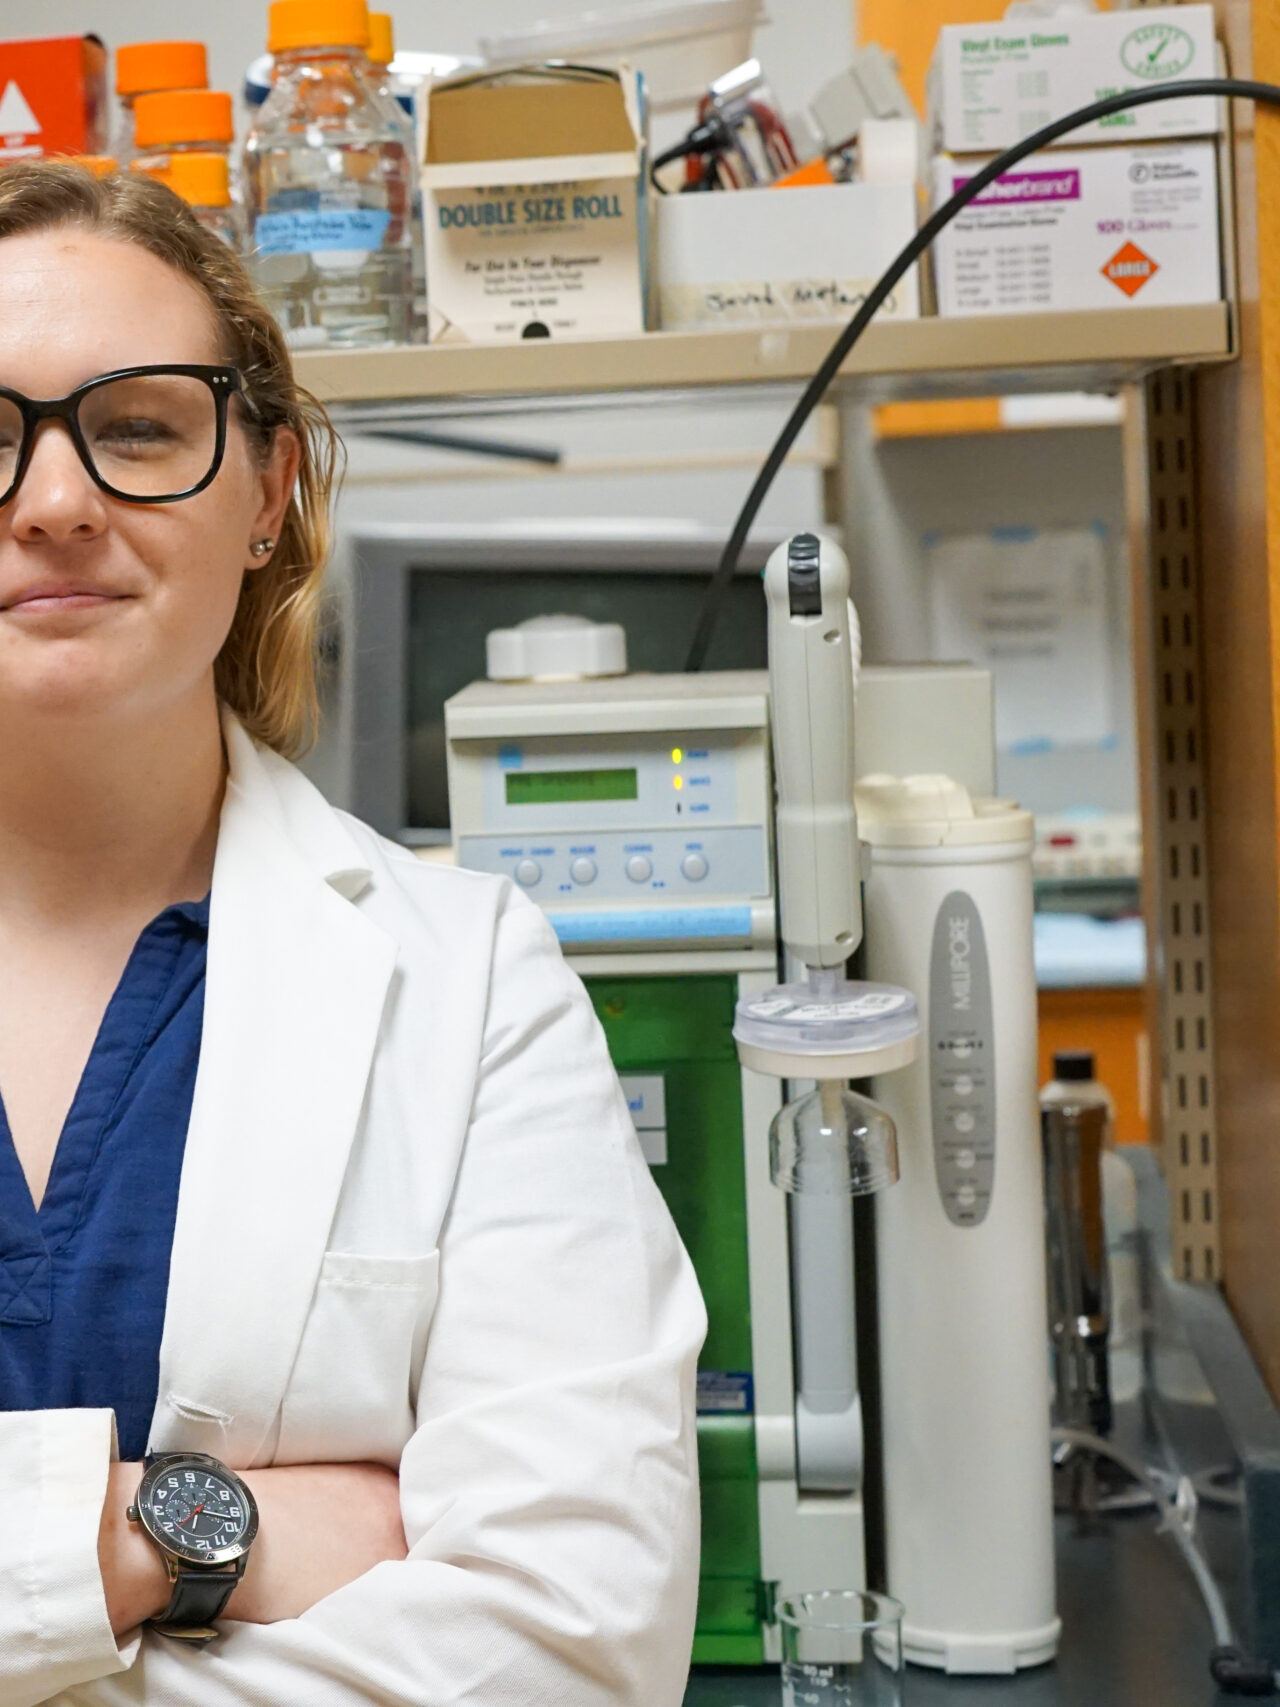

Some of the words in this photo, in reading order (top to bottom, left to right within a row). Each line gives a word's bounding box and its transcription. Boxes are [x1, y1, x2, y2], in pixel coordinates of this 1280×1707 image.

[439, 202, 516, 229] DOUBLE
[524, 197, 567, 223] SIZE
[573, 194, 622, 219] ROLL
[167, 1477, 179, 1488] 5
[184, 1472, 196, 1483] 6
[205, 1478, 215, 1488] 7
[156, 1488, 168, 1499] 4
[219, 1490, 230, 1501] 8
[153, 1505, 165, 1516] 3
[229, 1507, 240, 1518] 9
[162, 1521, 174, 1533] 2
[225, 1521, 240, 1533] 10
[180, 1535, 188, 1545] 1
[195, 1540, 213, 1550] 12
[214, 1535, 228, 1546] 11
